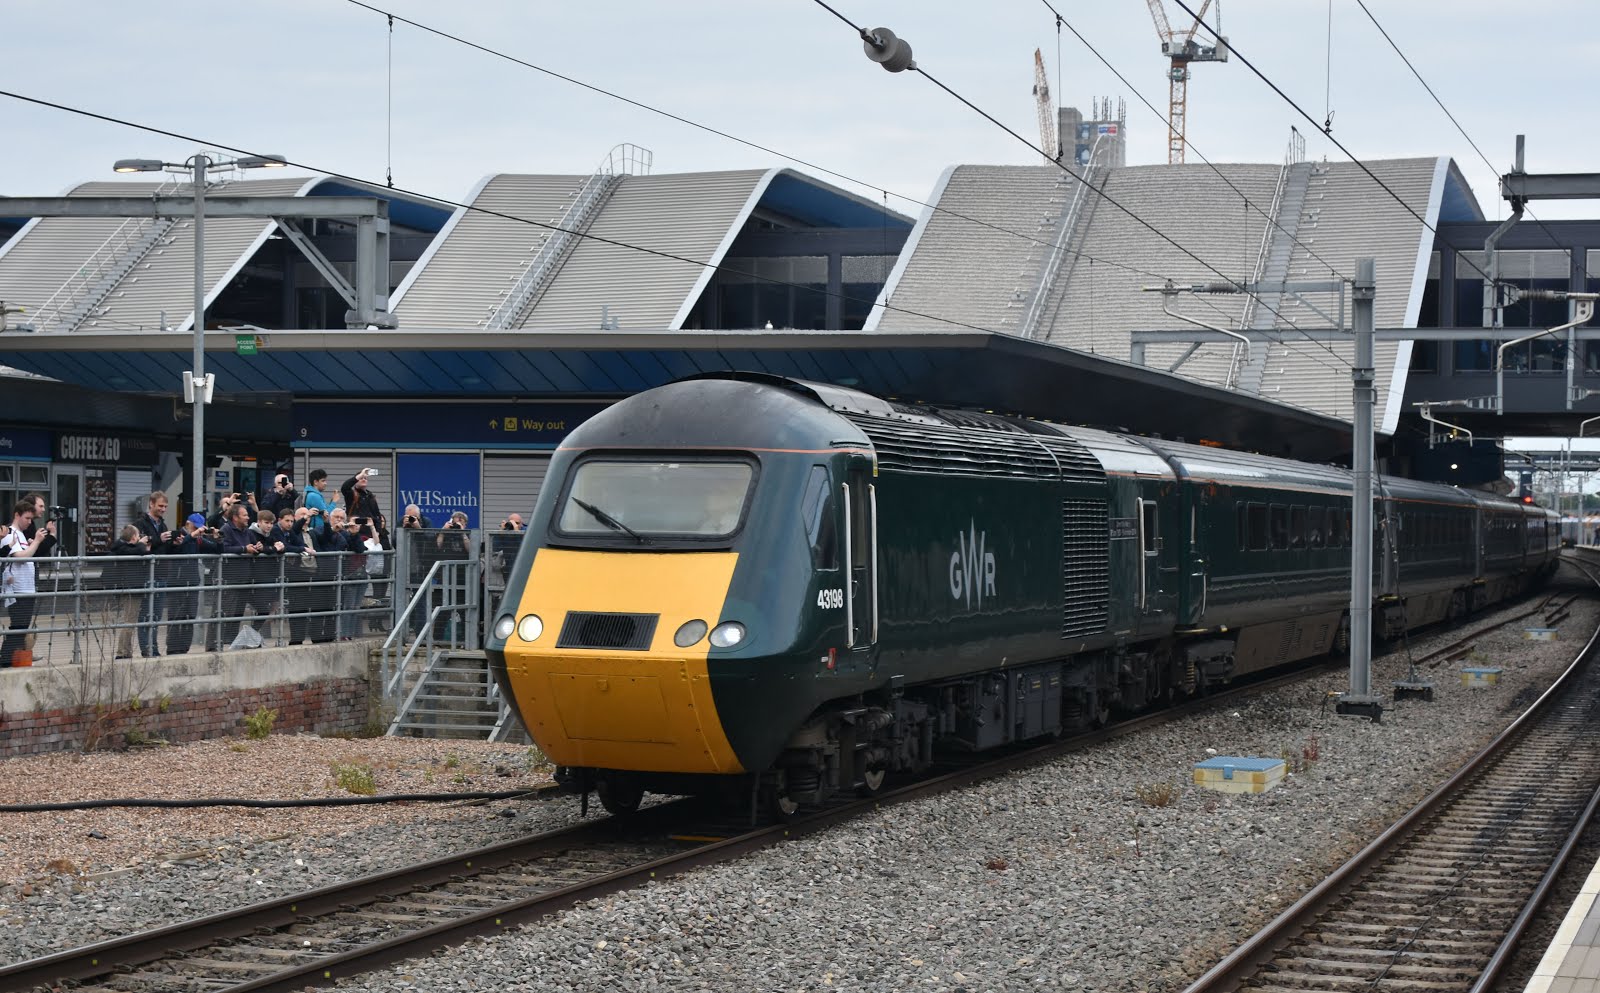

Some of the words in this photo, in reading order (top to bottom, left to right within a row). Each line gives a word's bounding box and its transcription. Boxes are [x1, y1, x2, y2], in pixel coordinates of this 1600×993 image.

[300, 427, 307, 438] 9
[522, 419, 544, 432] Way
[546, 419, 565, 430] out
[60, 435, 120, 461] COFFEE2GO
[400, 490, 478, 507] WHSmith
[949, 515, 997, 611] GWR
[817, 588, 844, 610] 43198
